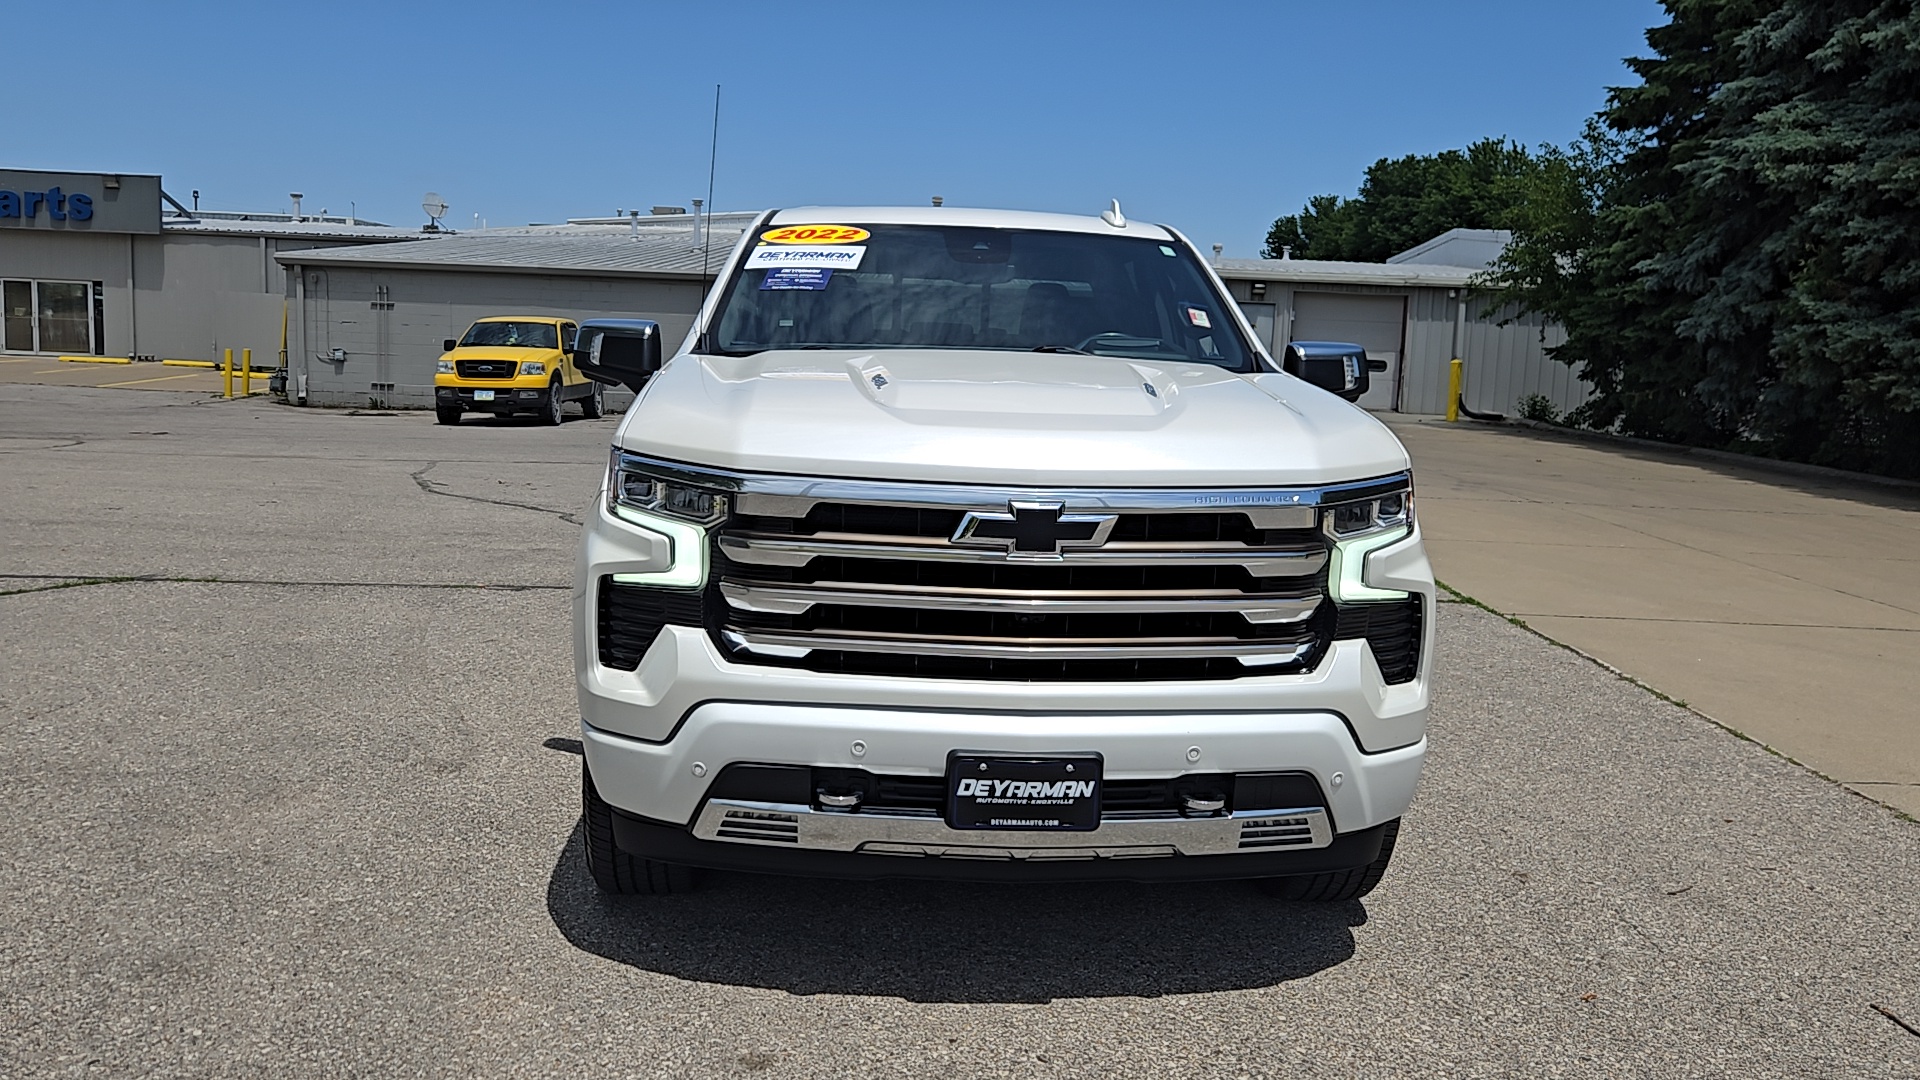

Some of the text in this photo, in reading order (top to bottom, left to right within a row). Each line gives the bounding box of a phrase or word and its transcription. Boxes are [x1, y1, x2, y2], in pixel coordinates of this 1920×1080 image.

[771, 229, 861, 240] 2022
[757, 251, 857, 259] DEYARMAN
[957, 779, 1095, 798] DEYARMAN
